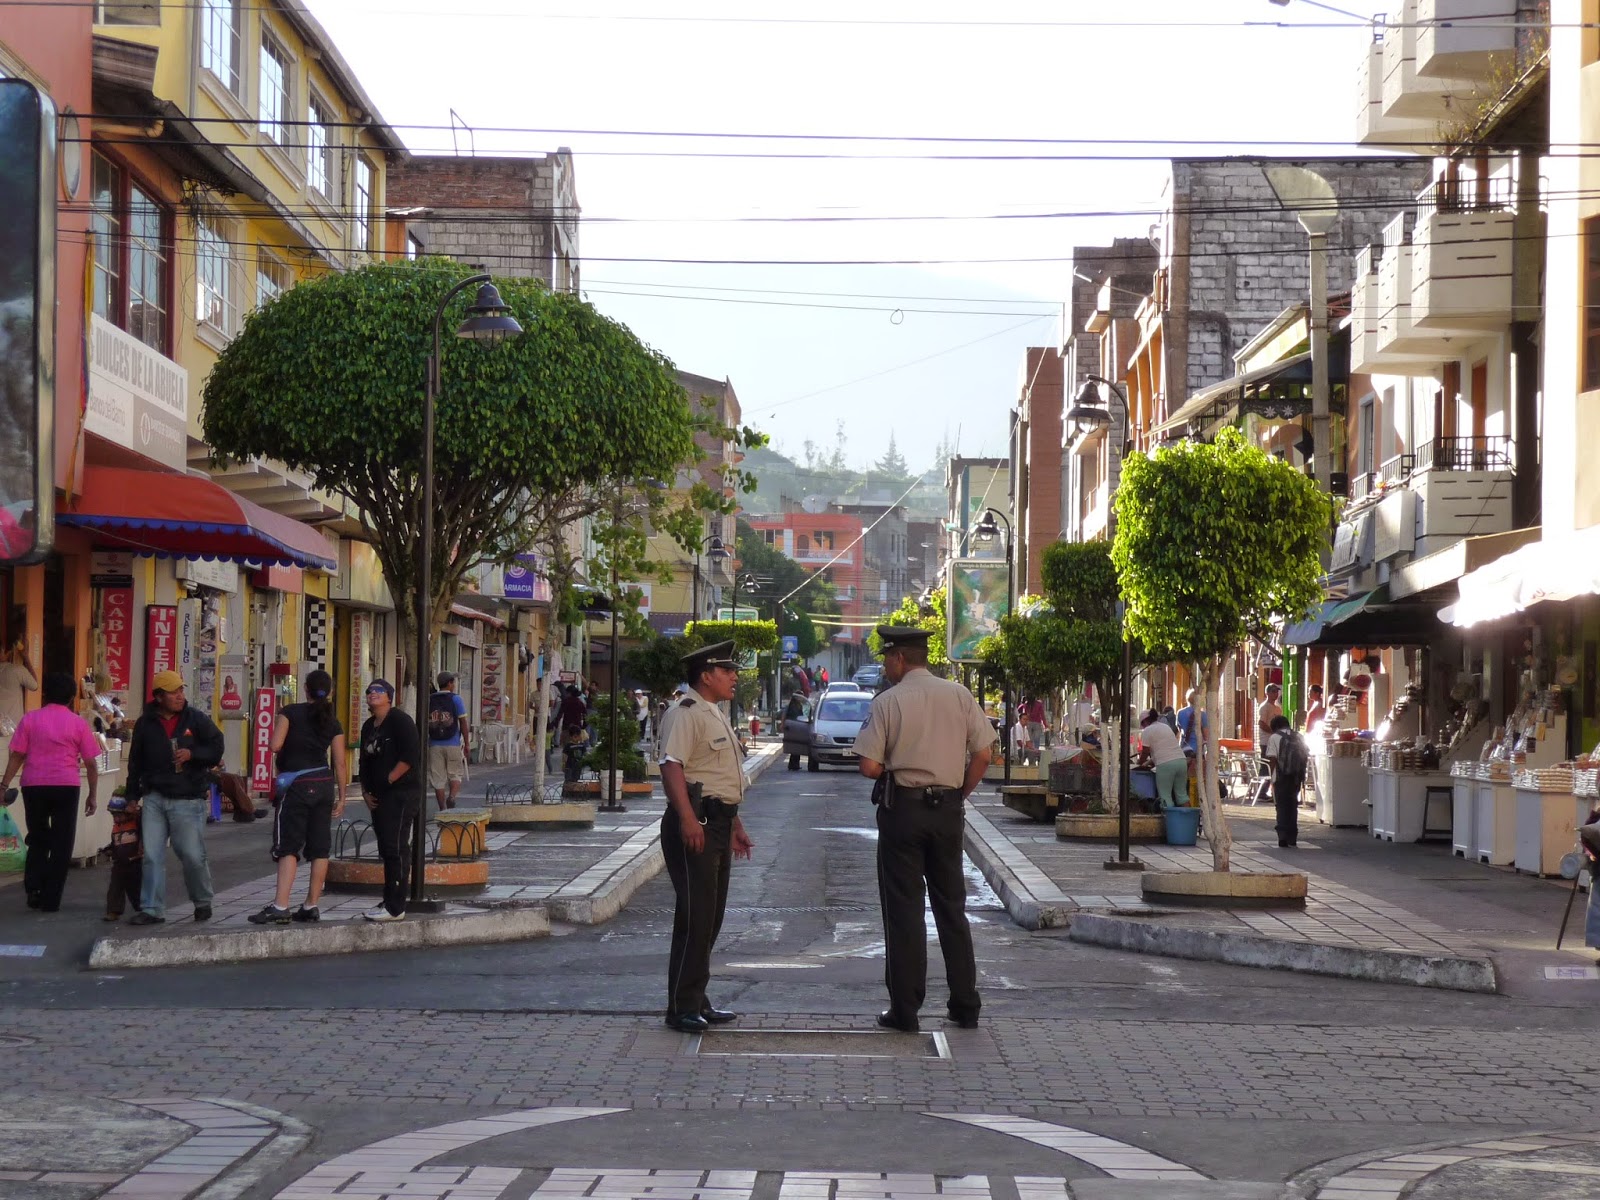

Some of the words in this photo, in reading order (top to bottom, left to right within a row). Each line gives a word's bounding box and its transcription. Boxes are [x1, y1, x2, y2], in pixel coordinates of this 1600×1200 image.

[96, 326, 130, 382] DULCES
[132, 347, 142, 388] DE
[144, 354, 153, 395] LA
[155, 361, 184, 413] ABUELA
[504, 584, 532, 592] ARMACIA
[106, 594, 125, 683] CABINAS
[154, 608, 171, 675] INTER
[255, 694, 271, 780] PORTA
